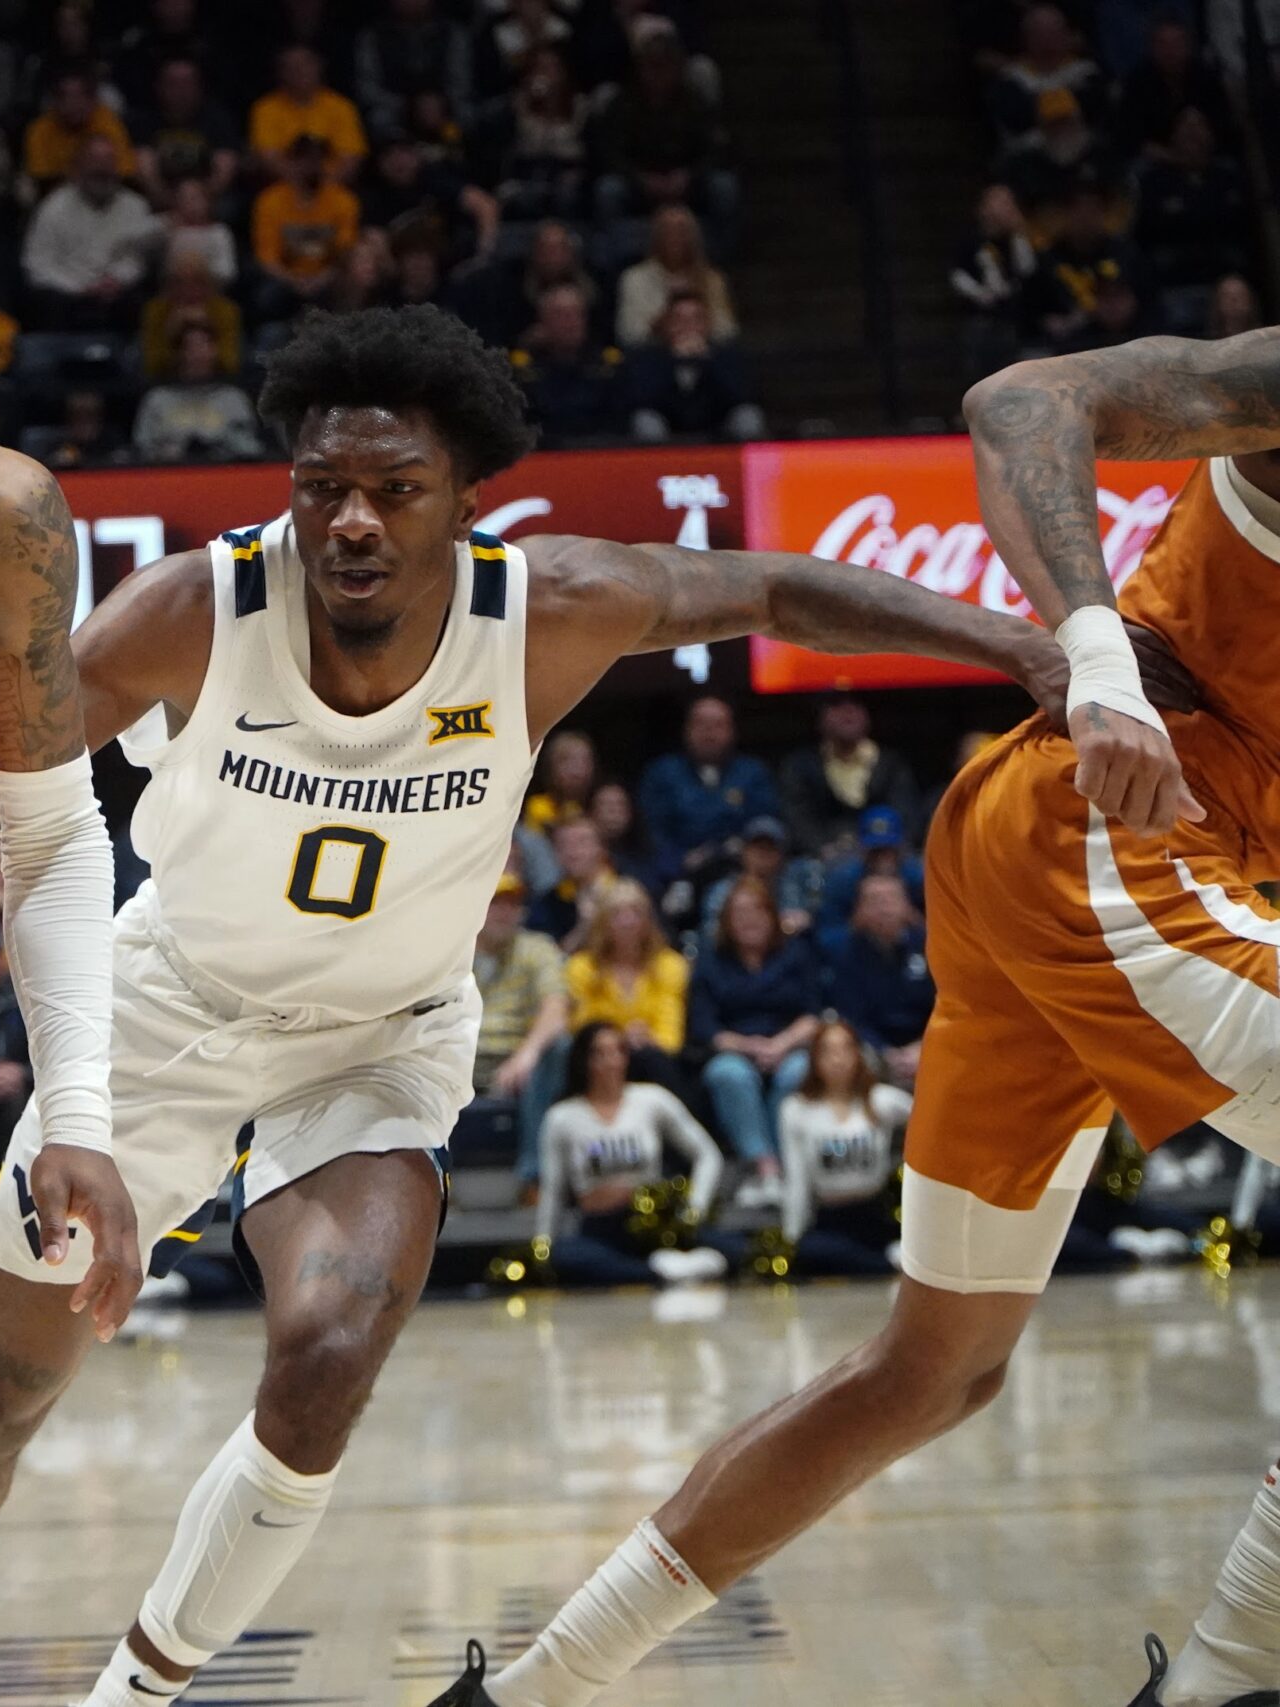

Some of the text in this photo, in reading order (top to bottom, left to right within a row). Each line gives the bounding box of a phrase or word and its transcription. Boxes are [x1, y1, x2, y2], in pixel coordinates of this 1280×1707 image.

[427, 701, 494, 744] XII
[219, 749, 490, 814] MOUNTAINEERS
[285, 823, 390, 922] 0
